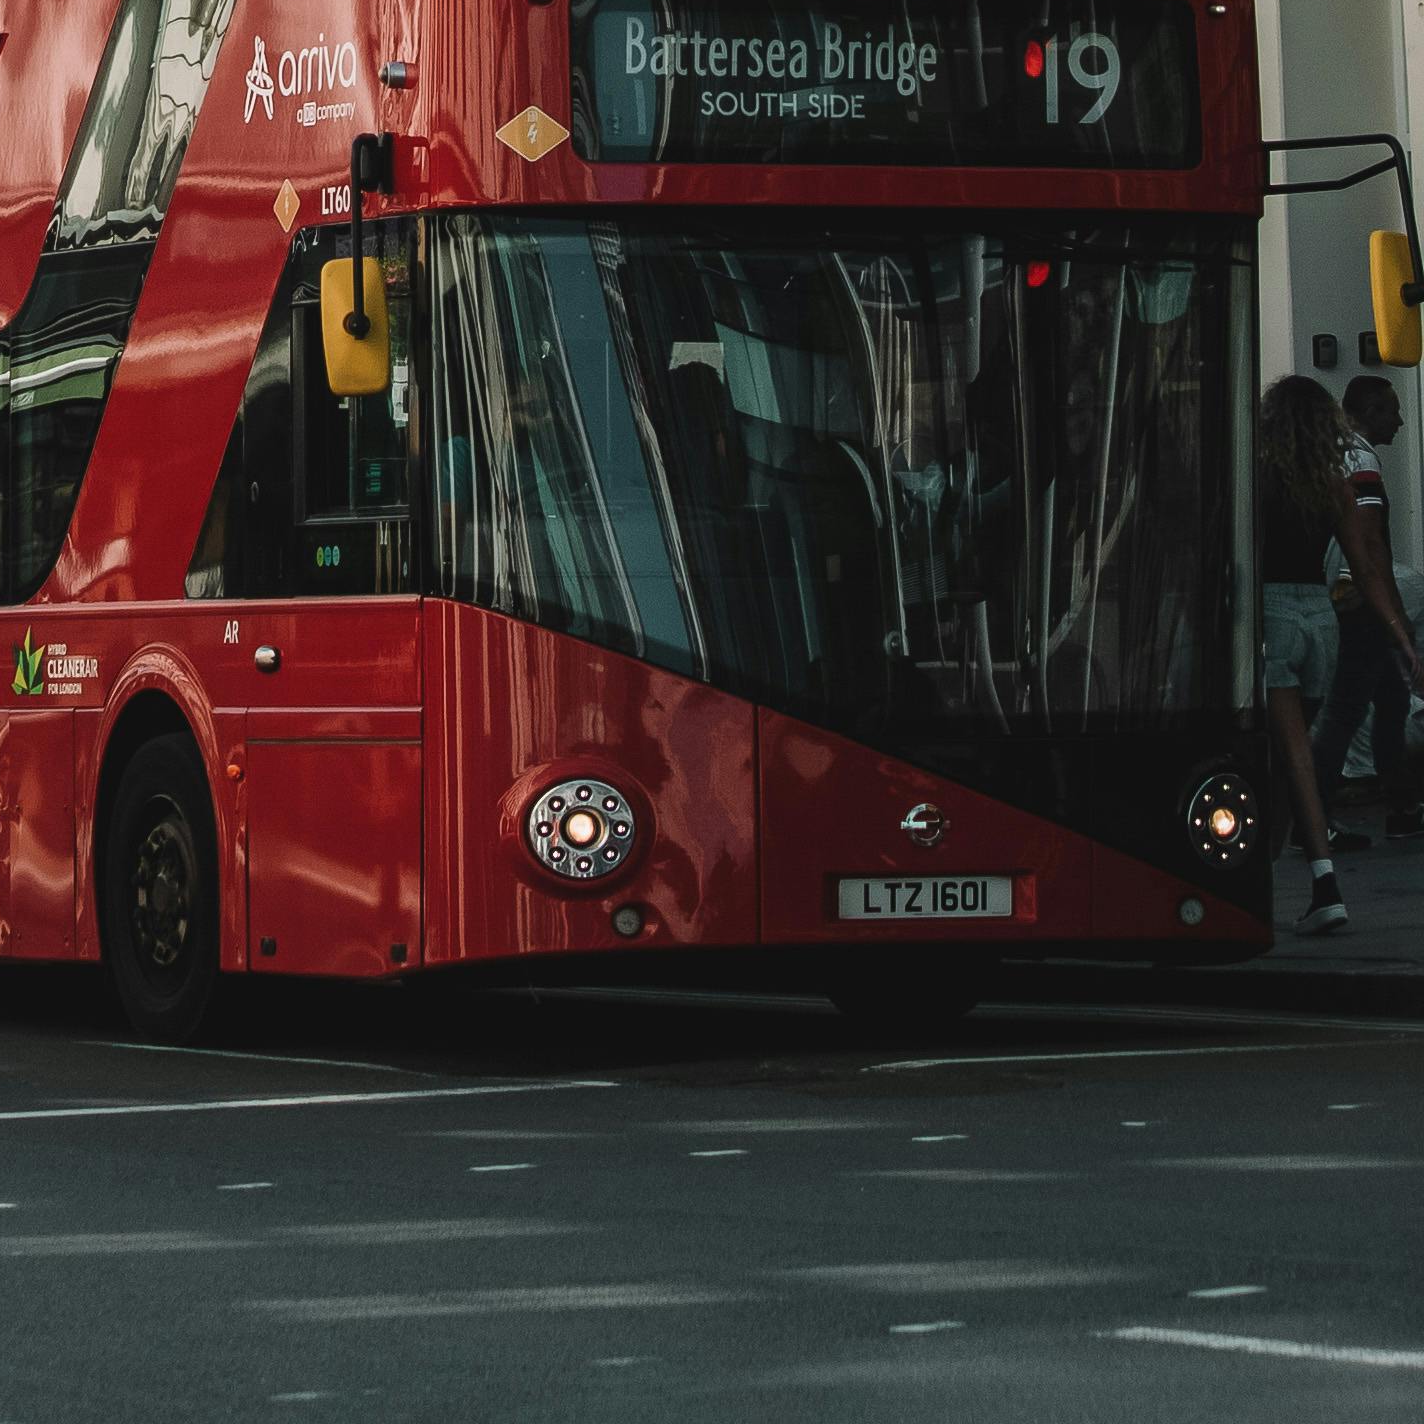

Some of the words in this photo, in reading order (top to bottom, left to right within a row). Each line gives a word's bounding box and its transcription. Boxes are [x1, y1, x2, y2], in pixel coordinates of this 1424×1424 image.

[278, 32, 357, 96] arriva
[625, 17, 808, 78] Battersea
[825, 22, 937, 96] Bridge
[1045, 33, 1120, 123] 19
[317, 101, 356, 123] company
[701, 91, 798, 117] SOUTH
[808, 93, 865, 118] SIDE
[223, 620, 239, 644] AR
[48, 683, 58, 694] FOR
[59, 683, 82, 694] LONDON
[863, 882, 923, 913] LTZ
[931, 880, 987, 912] 1601
